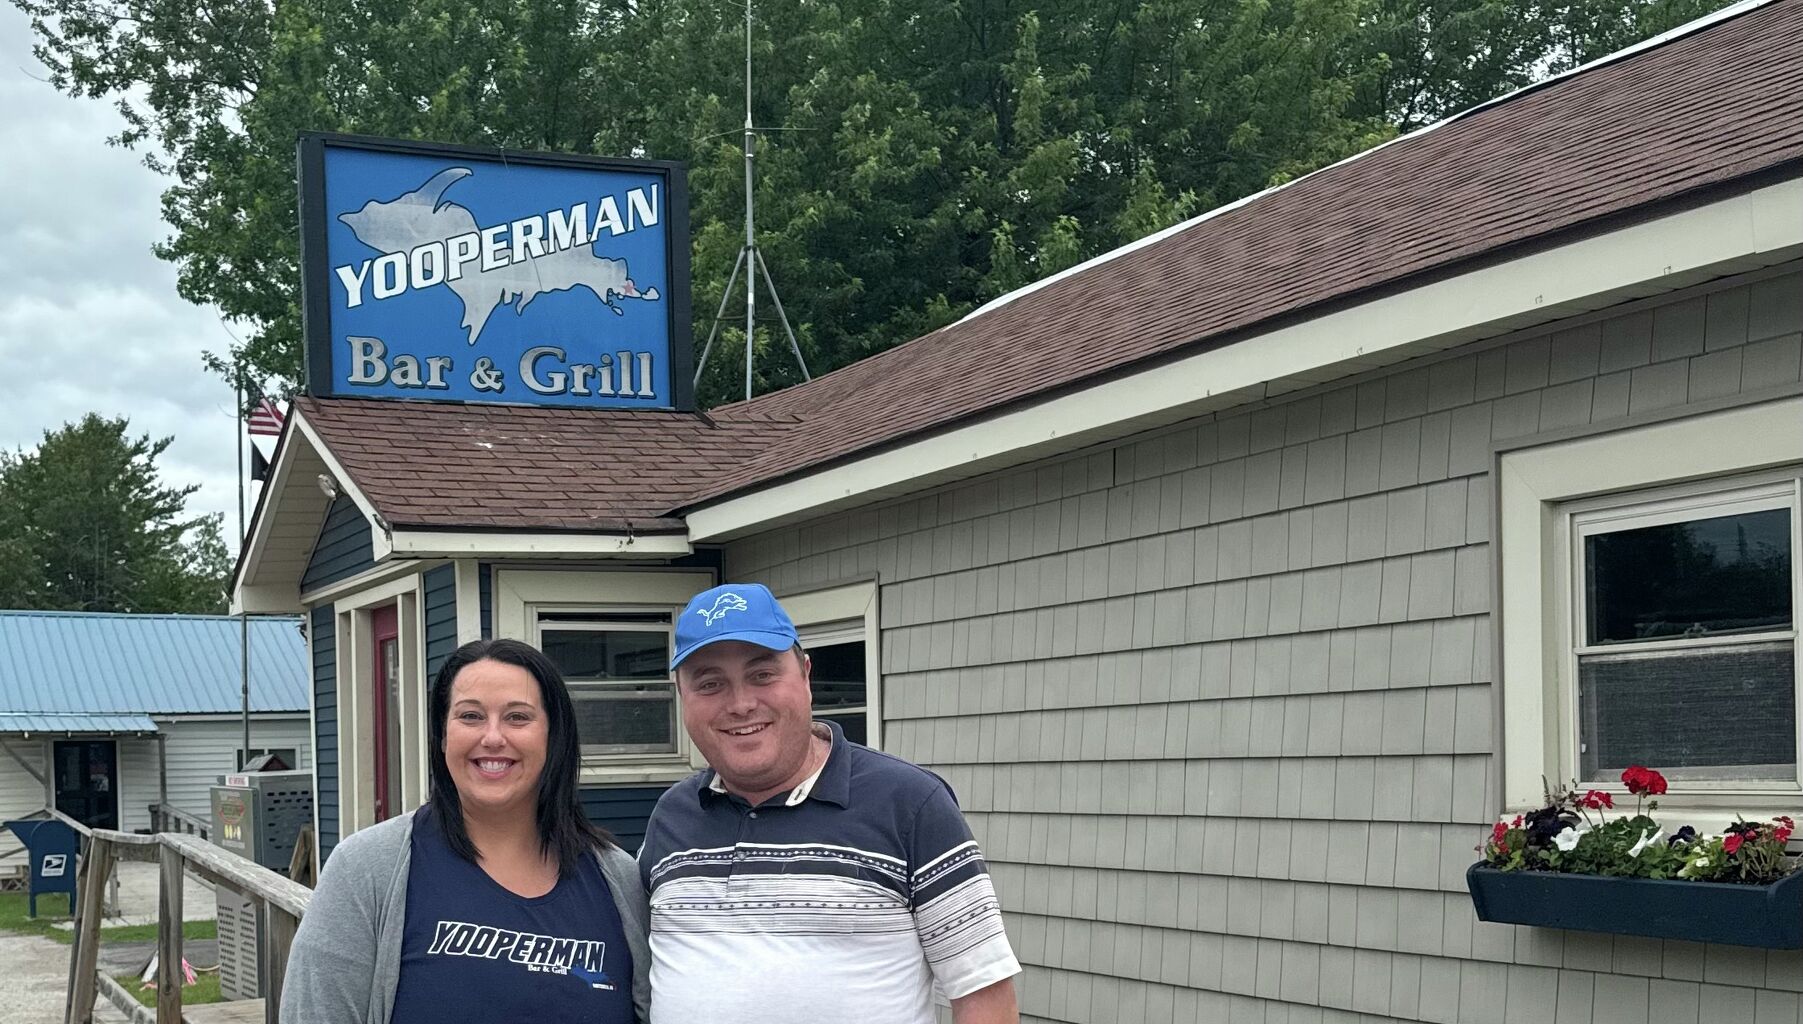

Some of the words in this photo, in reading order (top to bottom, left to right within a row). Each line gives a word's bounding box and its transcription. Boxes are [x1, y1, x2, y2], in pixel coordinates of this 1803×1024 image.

[335, 183, 659, 309] YOOPERMAN
[346, 336, 452, 388] Bar
[469, 357, 503, 392] &
[519, 346, 656, 398] Grill
[427, 920, 606, 973] YOOPERMAN
